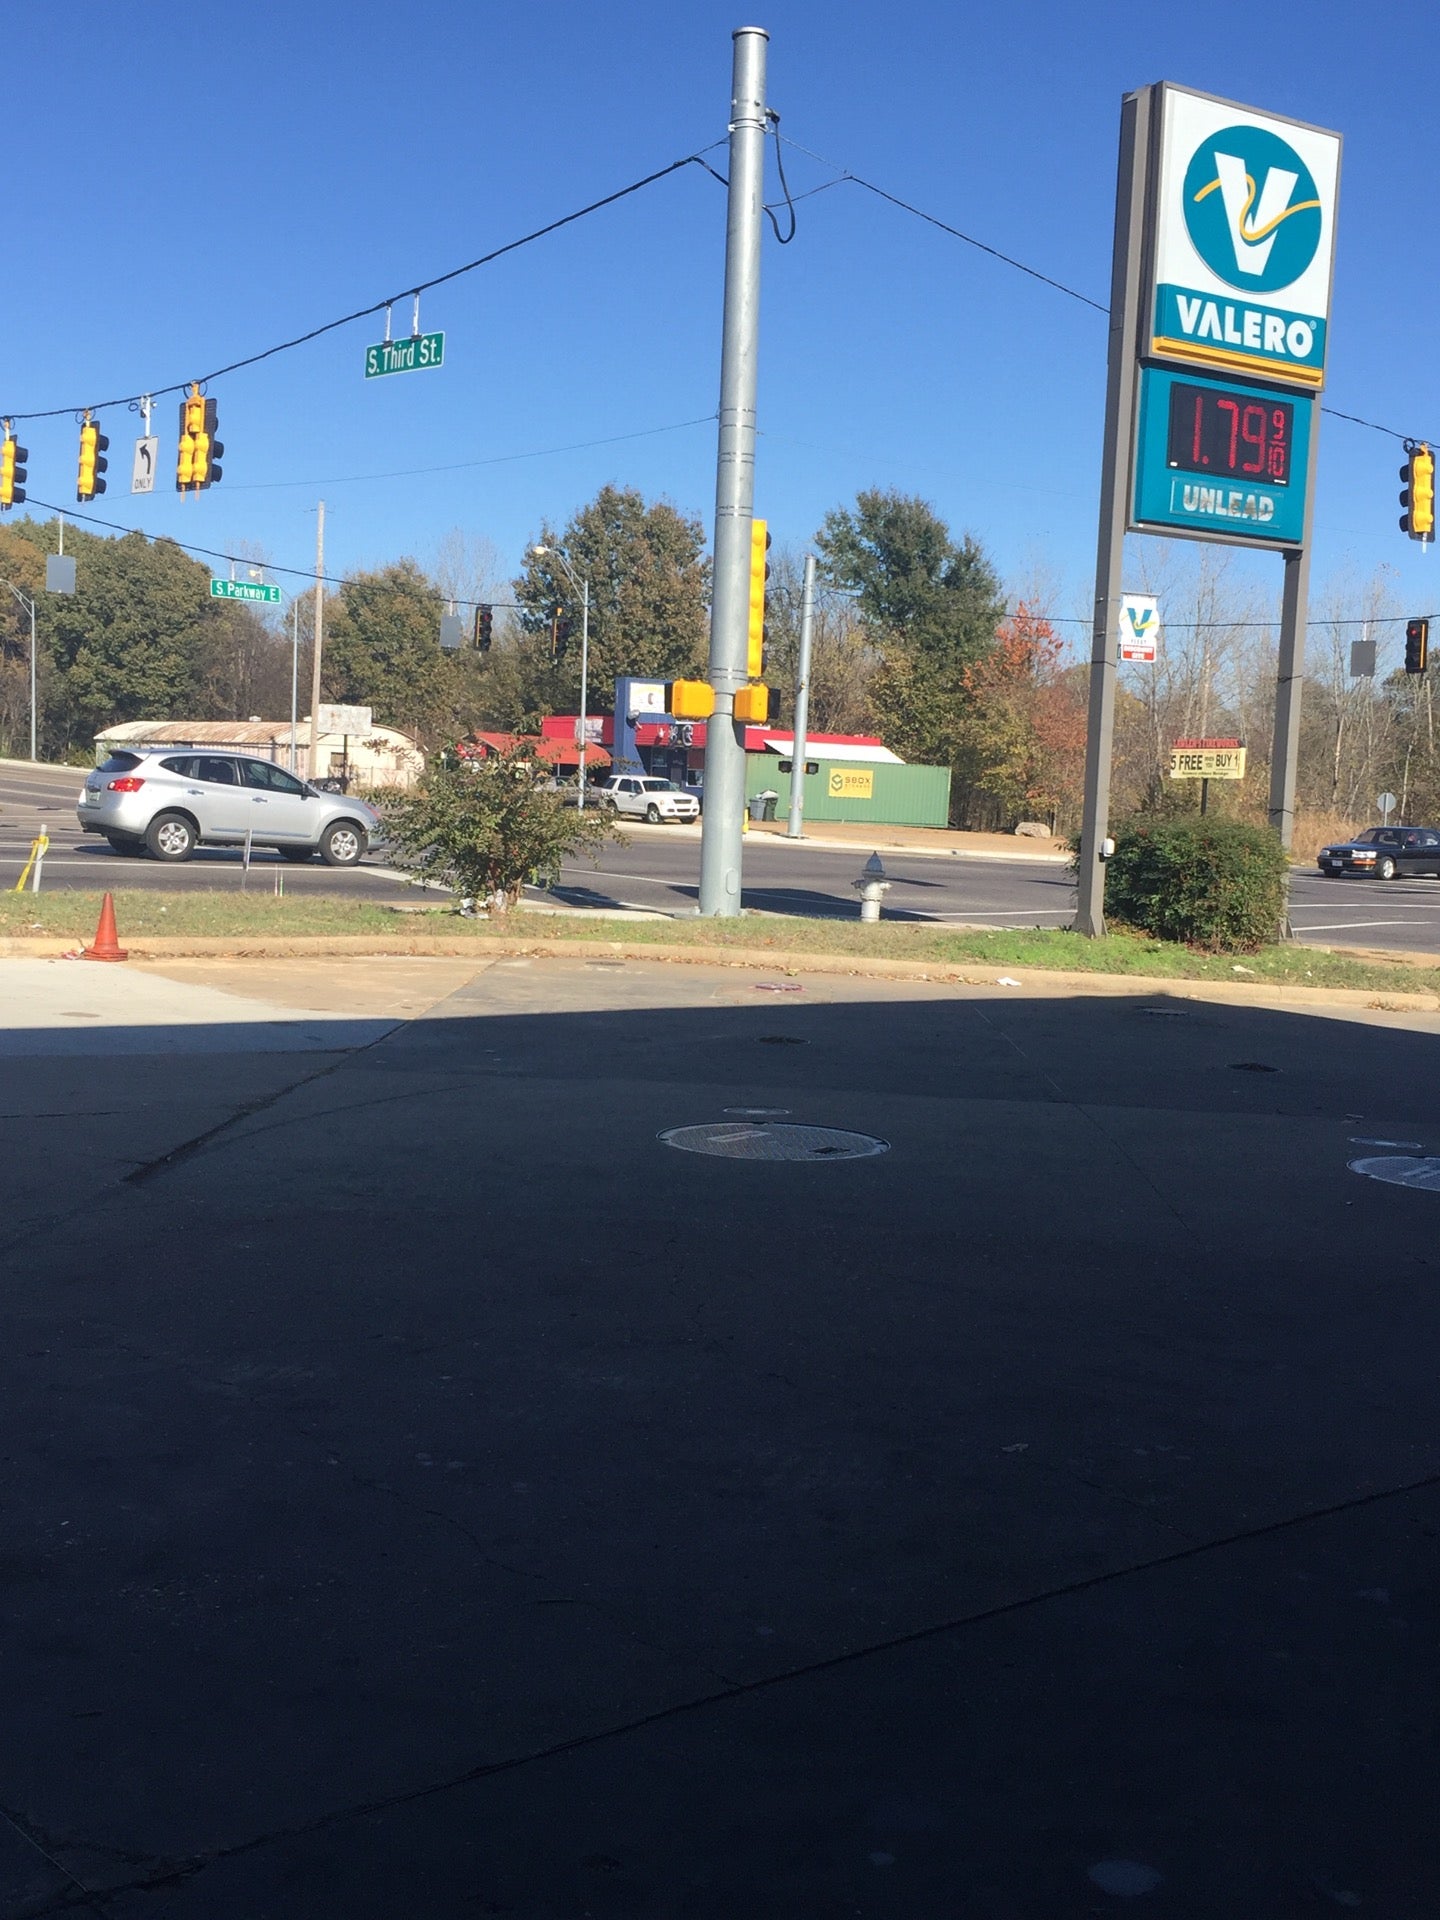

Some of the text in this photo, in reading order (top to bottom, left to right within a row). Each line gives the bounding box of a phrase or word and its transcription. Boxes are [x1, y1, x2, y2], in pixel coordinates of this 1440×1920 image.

[1176, 294, 1313, 358] VALERO
[368, 338, 441, 374] S. Third St.
[134, 477, 152, 490] ONLY
[1182, 484, 1275, 522] UNLEAD
[227, 583, 266, 601] Parkway
[270, 588, 277, 601] E
[1179, 754, 1203, 770] FREE
[1216, 754, 1232, 767] BUY
